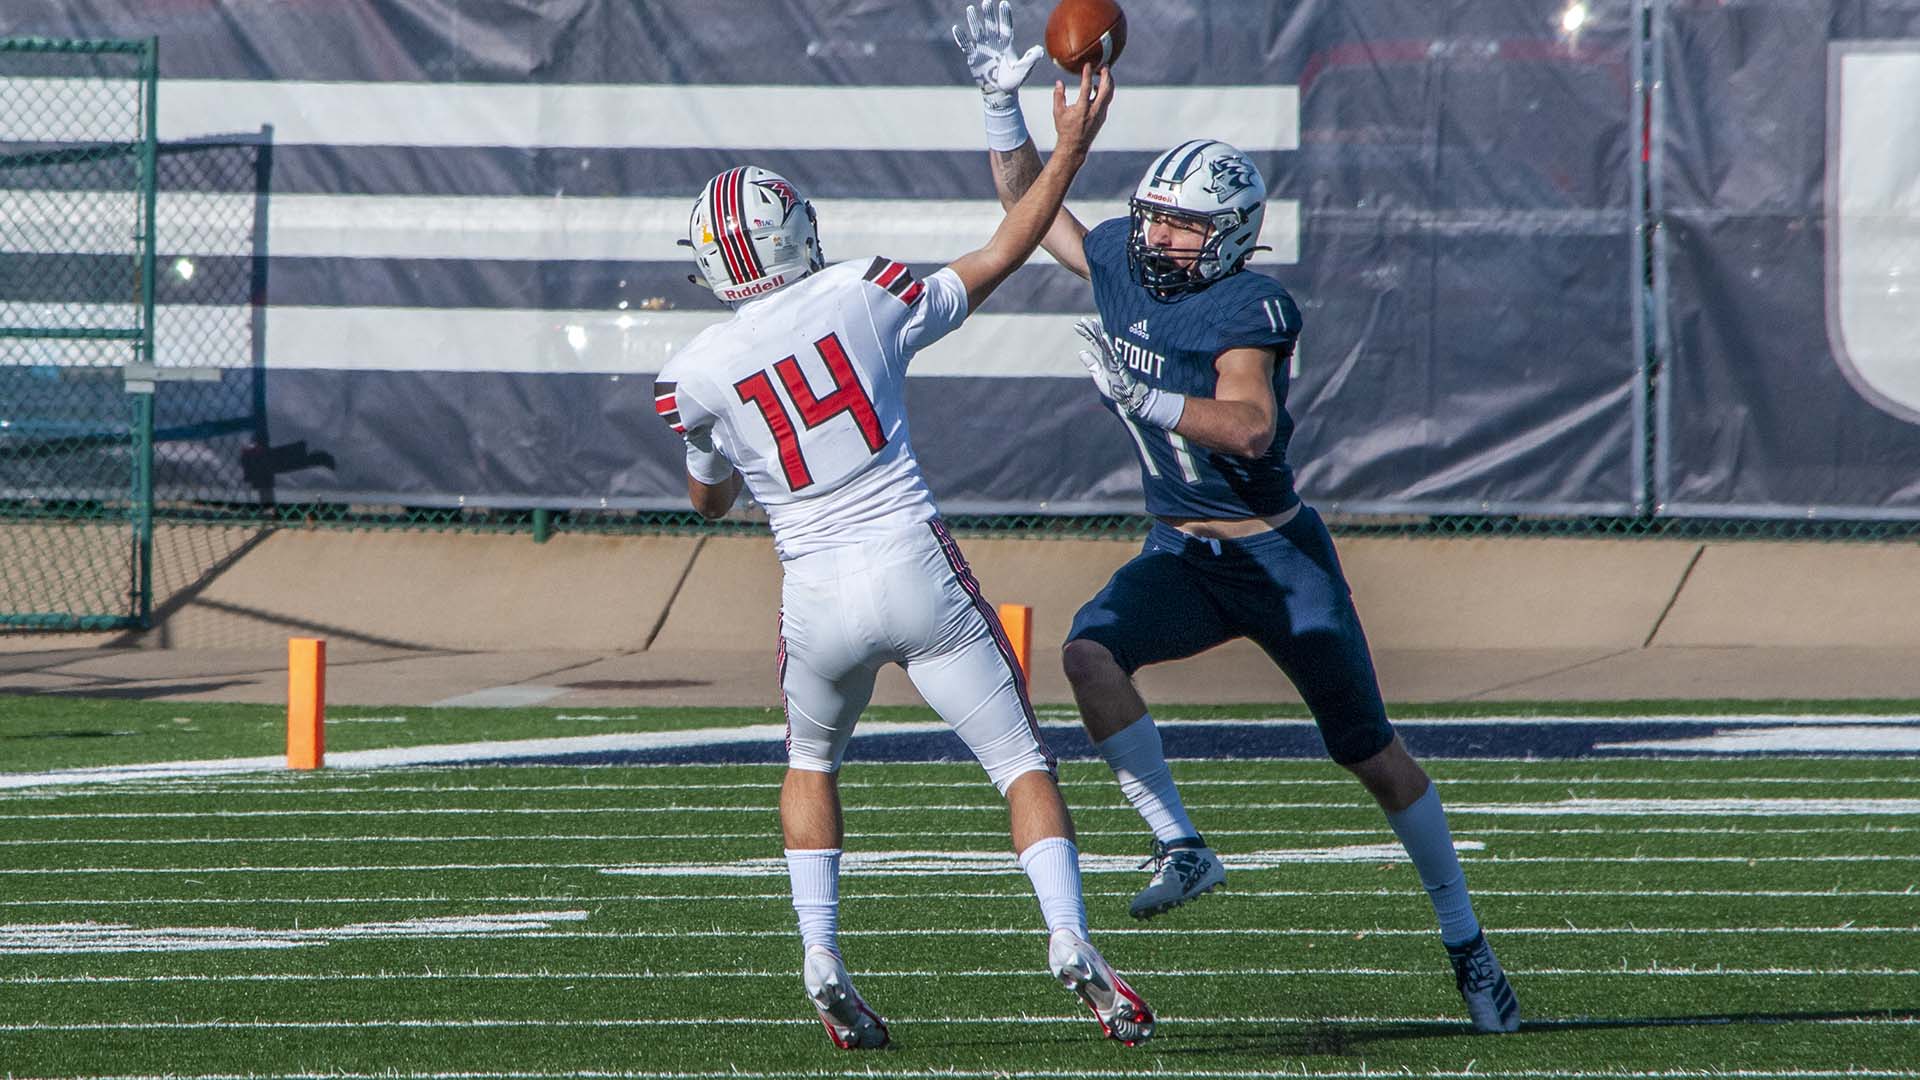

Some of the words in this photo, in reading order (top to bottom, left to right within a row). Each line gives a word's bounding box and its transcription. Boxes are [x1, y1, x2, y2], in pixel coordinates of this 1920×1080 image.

[1147, 192, 1172, 203] Riddell
[725, 275, 785, 300] Riddell
[1263, 299, 1287, 333] 11
[1129, 326, 1150, 340] adidas
[1114, 336, 1165, 379] STOUT
[733, 331, 889, 492] 14
